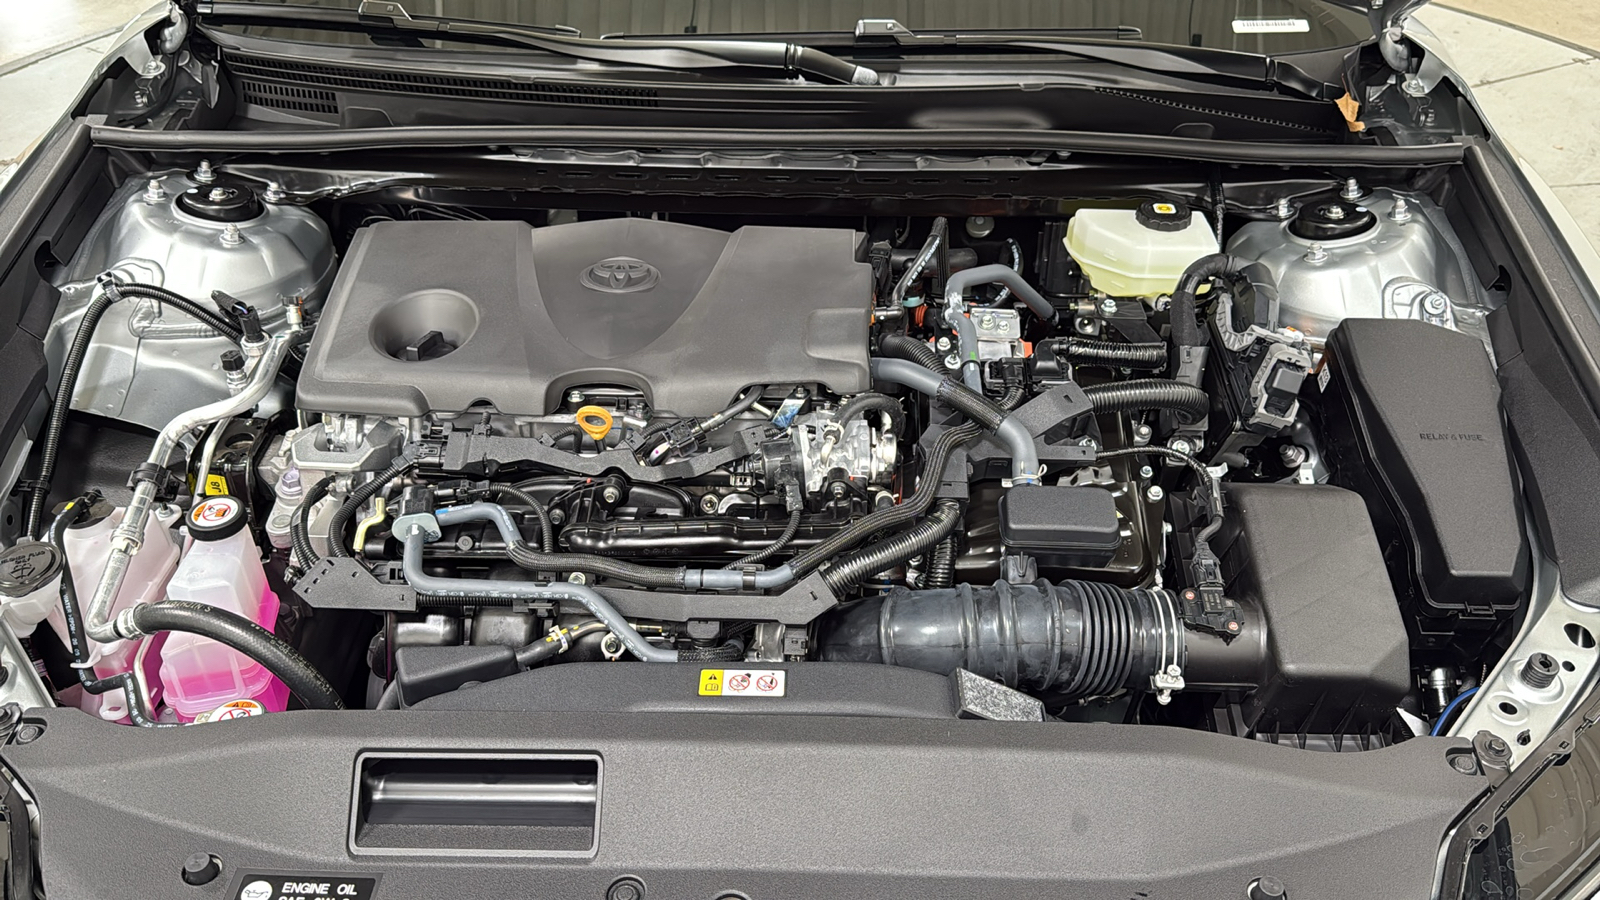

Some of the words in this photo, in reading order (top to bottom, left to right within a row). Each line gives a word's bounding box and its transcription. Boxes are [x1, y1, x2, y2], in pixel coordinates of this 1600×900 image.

[1419, 432, 1449, 441] RELAY
[1450, 433, 1458, 441] &
[1458, 433, 1484, 441] FUSE
[62, 593, 73, 613] WATER
[281, 882, 331, 895] ENGINE
[336, 883, 358, 895] OIL
